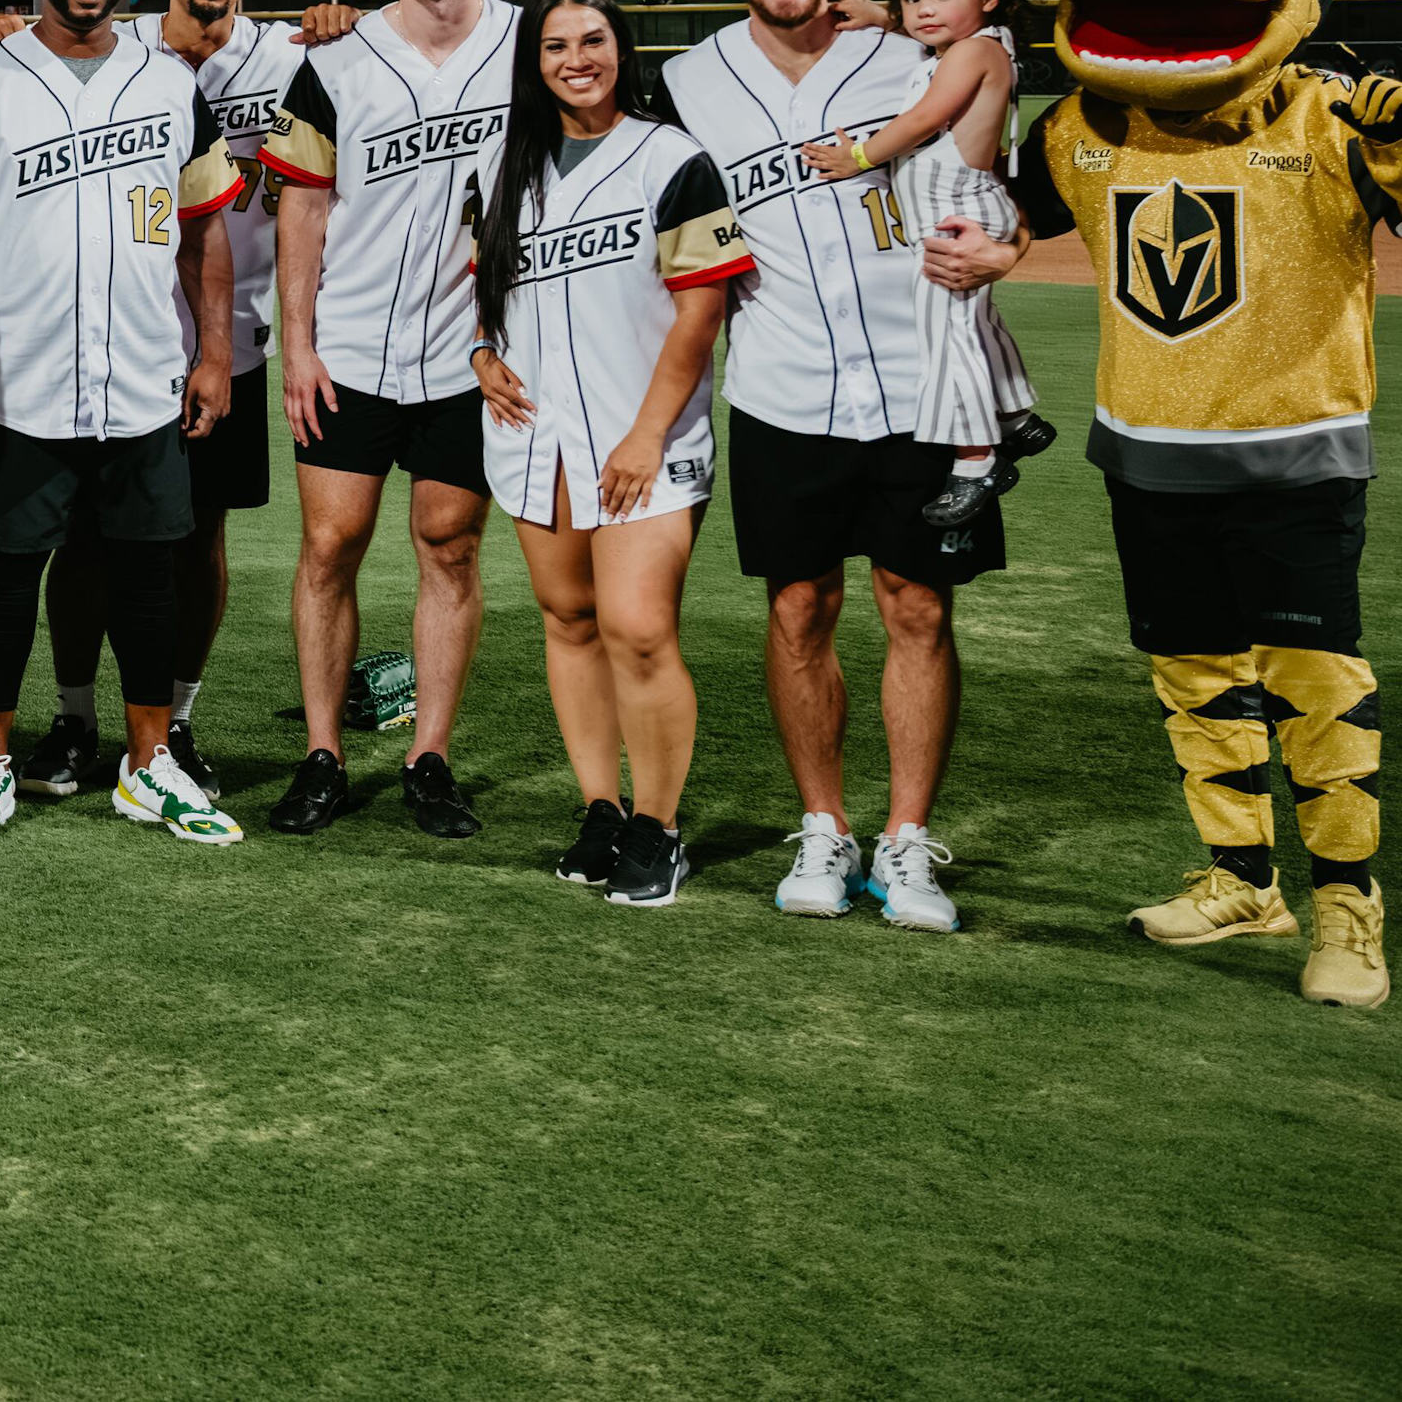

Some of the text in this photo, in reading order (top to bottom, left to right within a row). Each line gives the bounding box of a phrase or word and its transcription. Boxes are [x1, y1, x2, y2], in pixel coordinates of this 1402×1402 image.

[209, 98, 277, 131] EGAS
[17, 141, 76, 188] LAS
[81, 121, 171, 167] VEGAS
[366, 114, 504, 174] LAS VEGA
[1072, 139, 1114, 168] Circa
[731, 153, 787, 202] LAS
[127, 184, 173, 247] 12
[713, 222, 743, 248] B4
[540, 218, 643, 270] VEGAS
